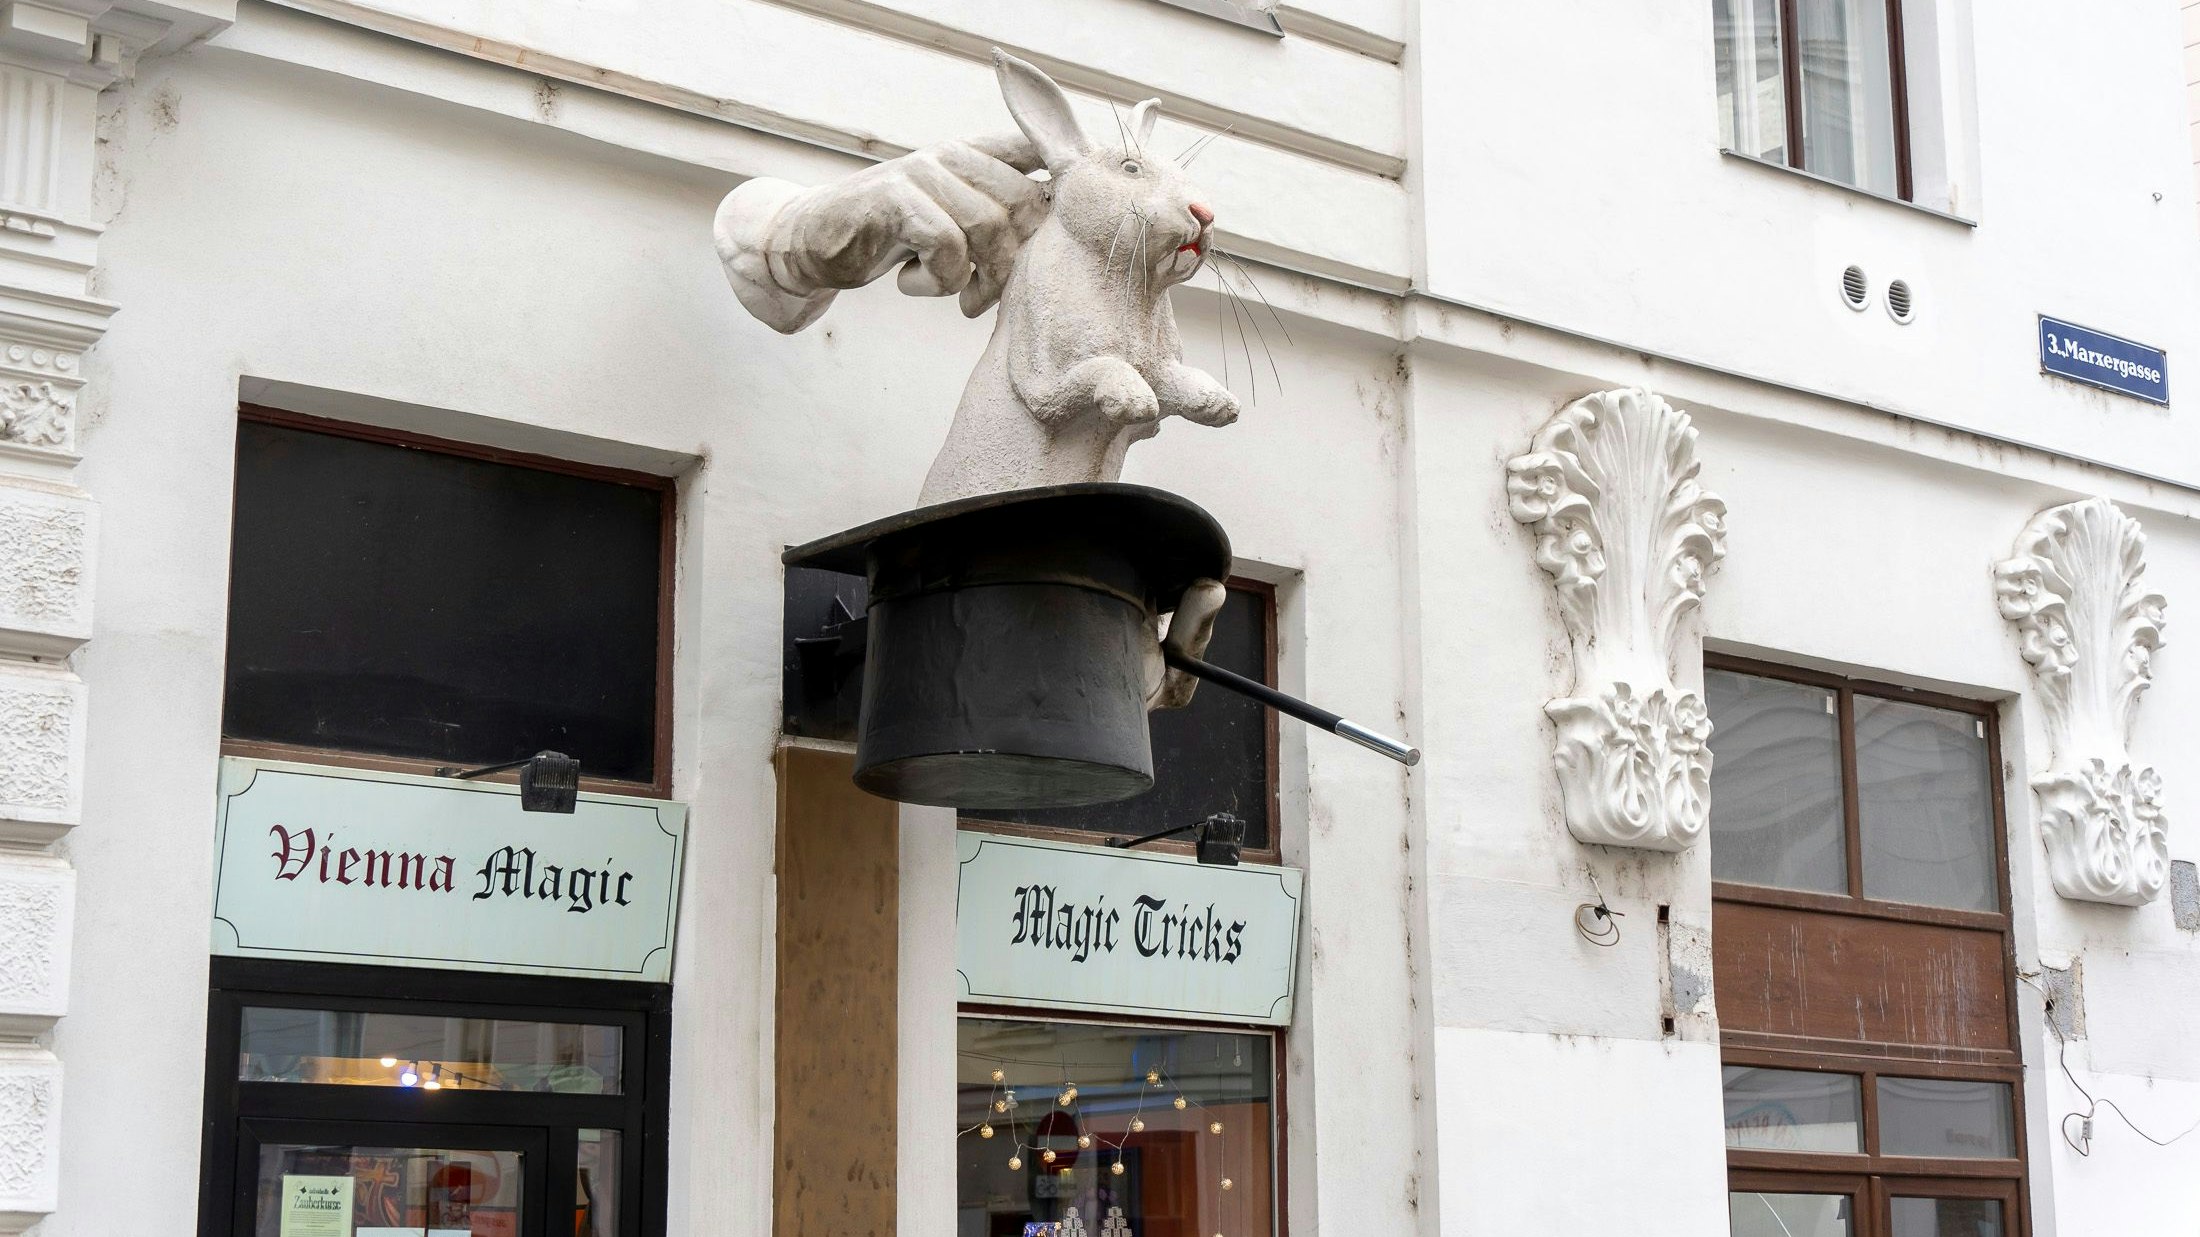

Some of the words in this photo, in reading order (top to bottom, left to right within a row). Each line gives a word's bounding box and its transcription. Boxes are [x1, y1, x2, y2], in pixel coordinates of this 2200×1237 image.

[269, 824, 457, 893] Vienna
[472, 845, 634, 914] Magic
[1011, 884, 1120, 963] Magic
[1132, 894, 1247, 965] Tricks
